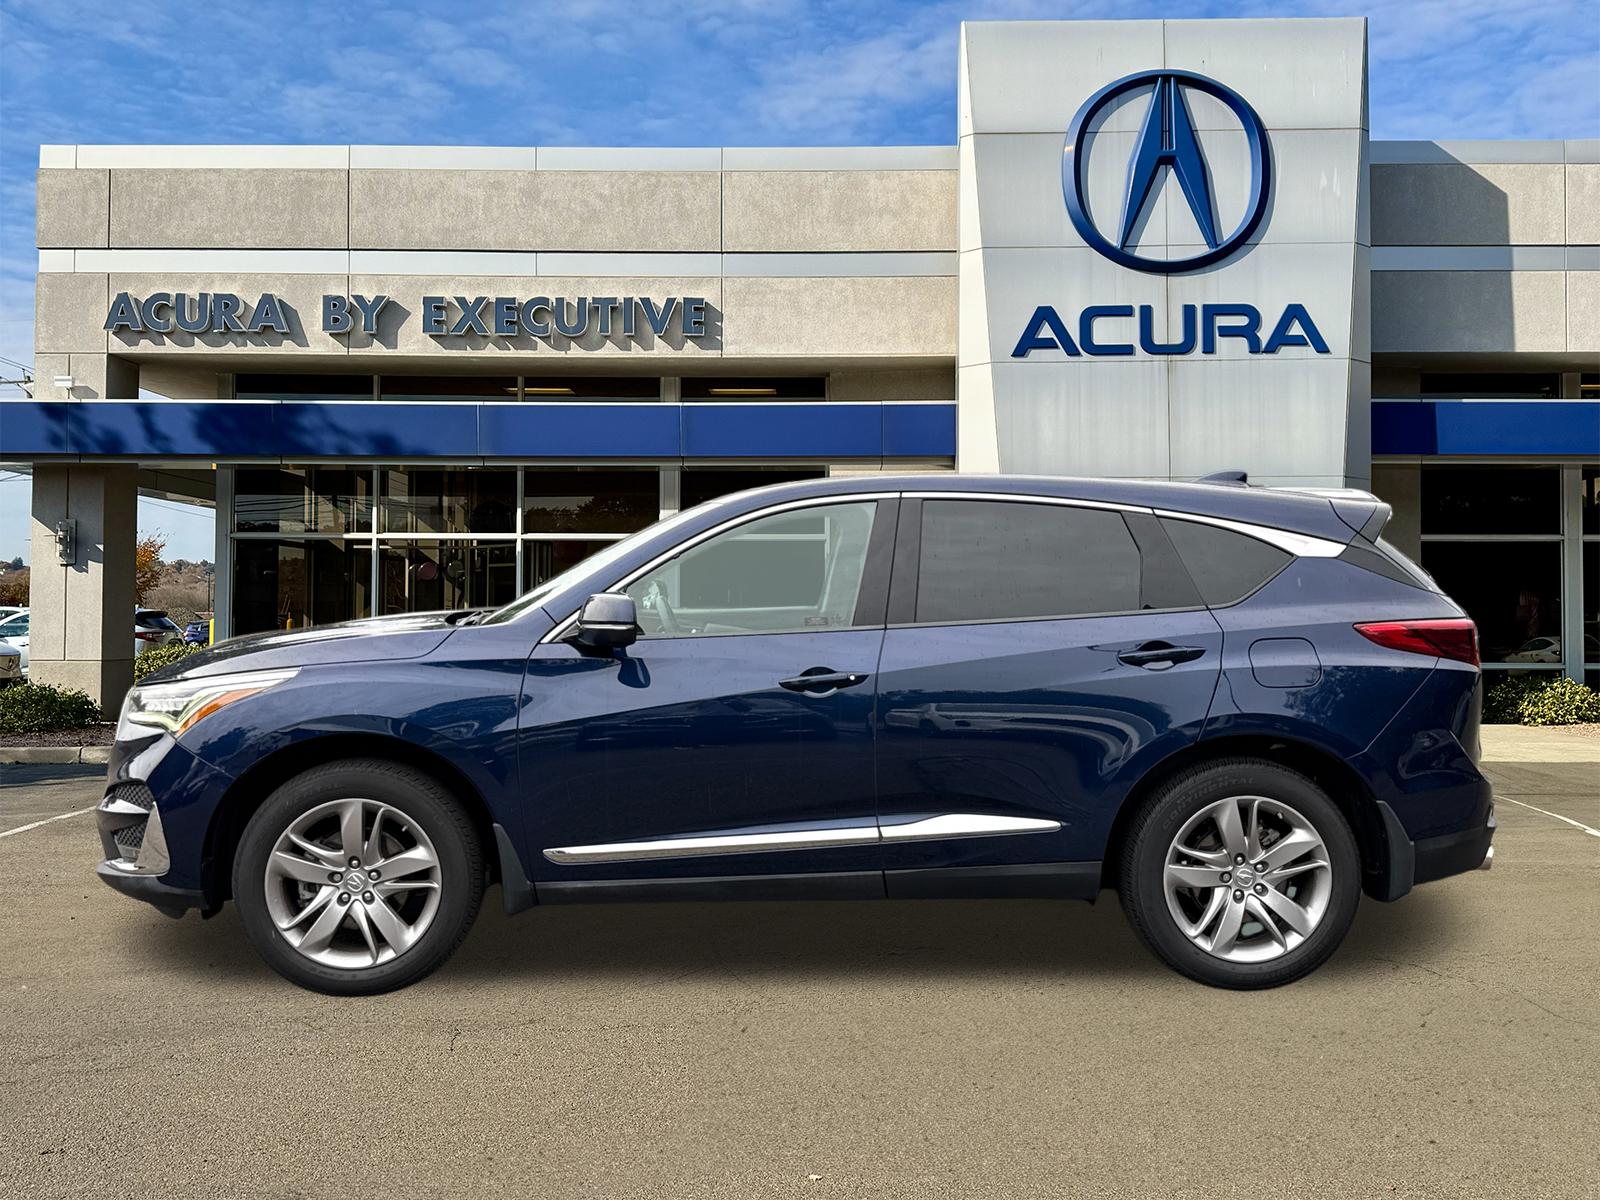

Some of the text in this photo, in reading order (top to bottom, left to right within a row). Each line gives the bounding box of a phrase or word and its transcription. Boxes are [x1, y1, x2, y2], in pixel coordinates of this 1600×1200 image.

[104, 292, 707, 338] ACURA BY EXECUTIVE
[1011, 303, 1332, 358] ACURA
